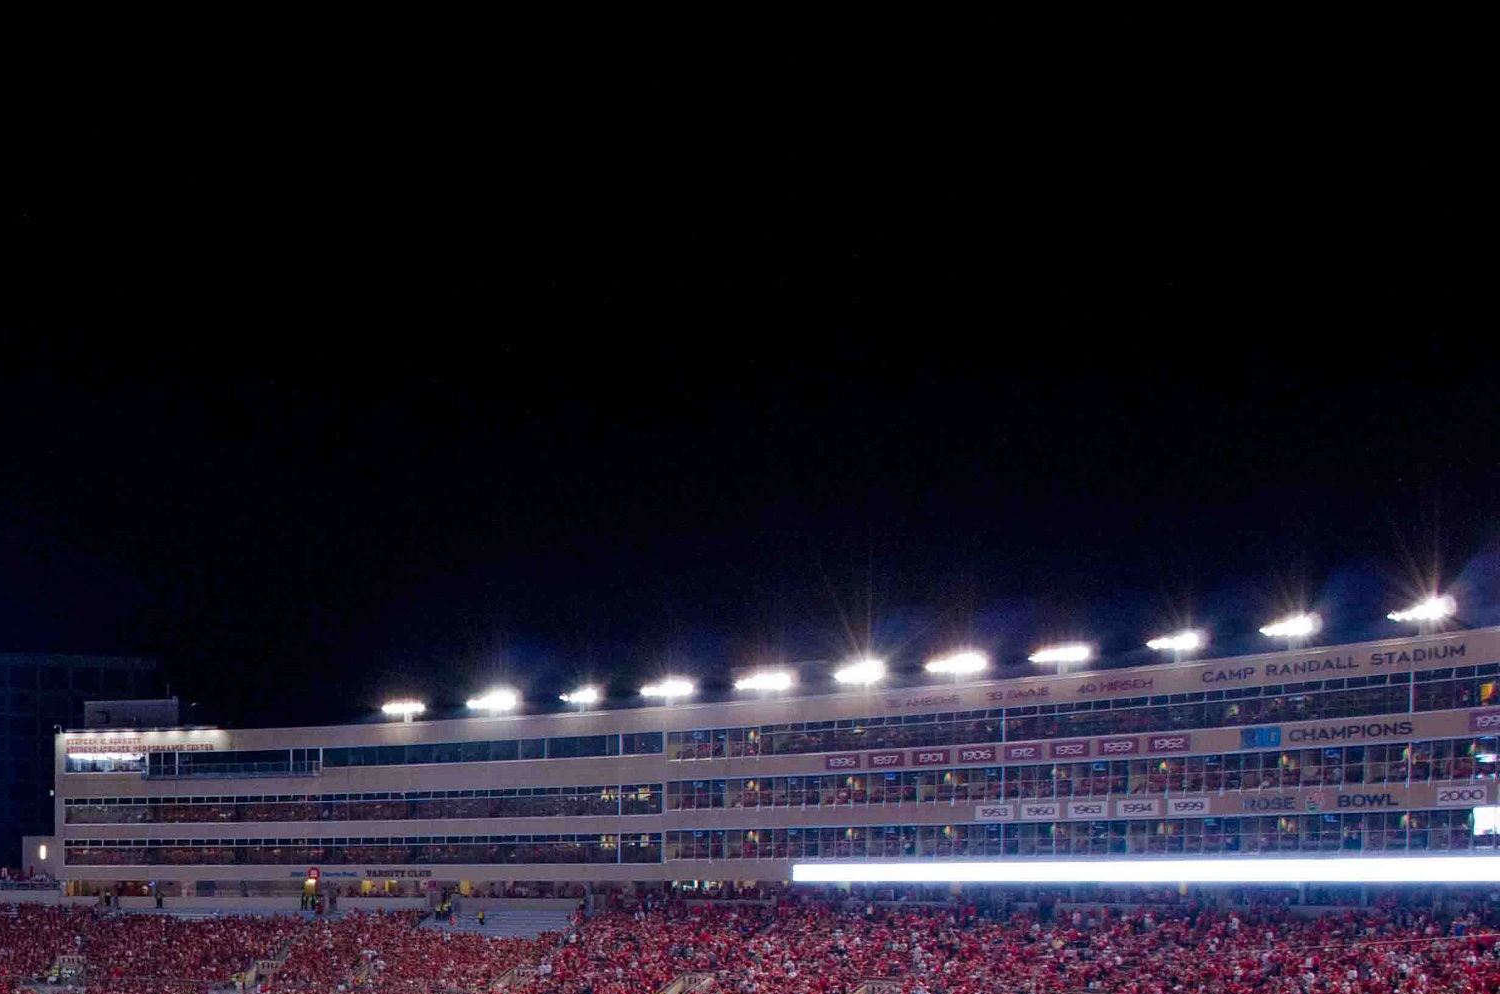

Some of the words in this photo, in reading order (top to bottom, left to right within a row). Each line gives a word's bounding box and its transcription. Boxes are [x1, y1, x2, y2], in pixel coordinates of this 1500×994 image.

[1202, 667, 1255, 683] CAMP
[1265, 656, 1359, 678] RANDALL
[1369, 644, 1466, 666] STADIUM
[1288, 721, 1414, 743] CHAMPIONS
[1055, 744, 1085, 755] 1952
[1103, 741, 1133, 753] 1959
[1154, 738, 1185, 750] 1962
[918, 752, 944, 763] 1901
[961, 750, 992, 762] 1906
[1010, 747, 1035, 758] 1912
[872, 755, 899, 766] 1897
[1439, 789, 1484, 802] 2000
[1174, 801, 1205, 812] 1999
[1242, 796, 1296, 811] ROSE
[1337, 793, 1399, 808] BOWL
[1026, 806, 1056, 817] 1960
[1123, 803, 1152, 814] 1994
